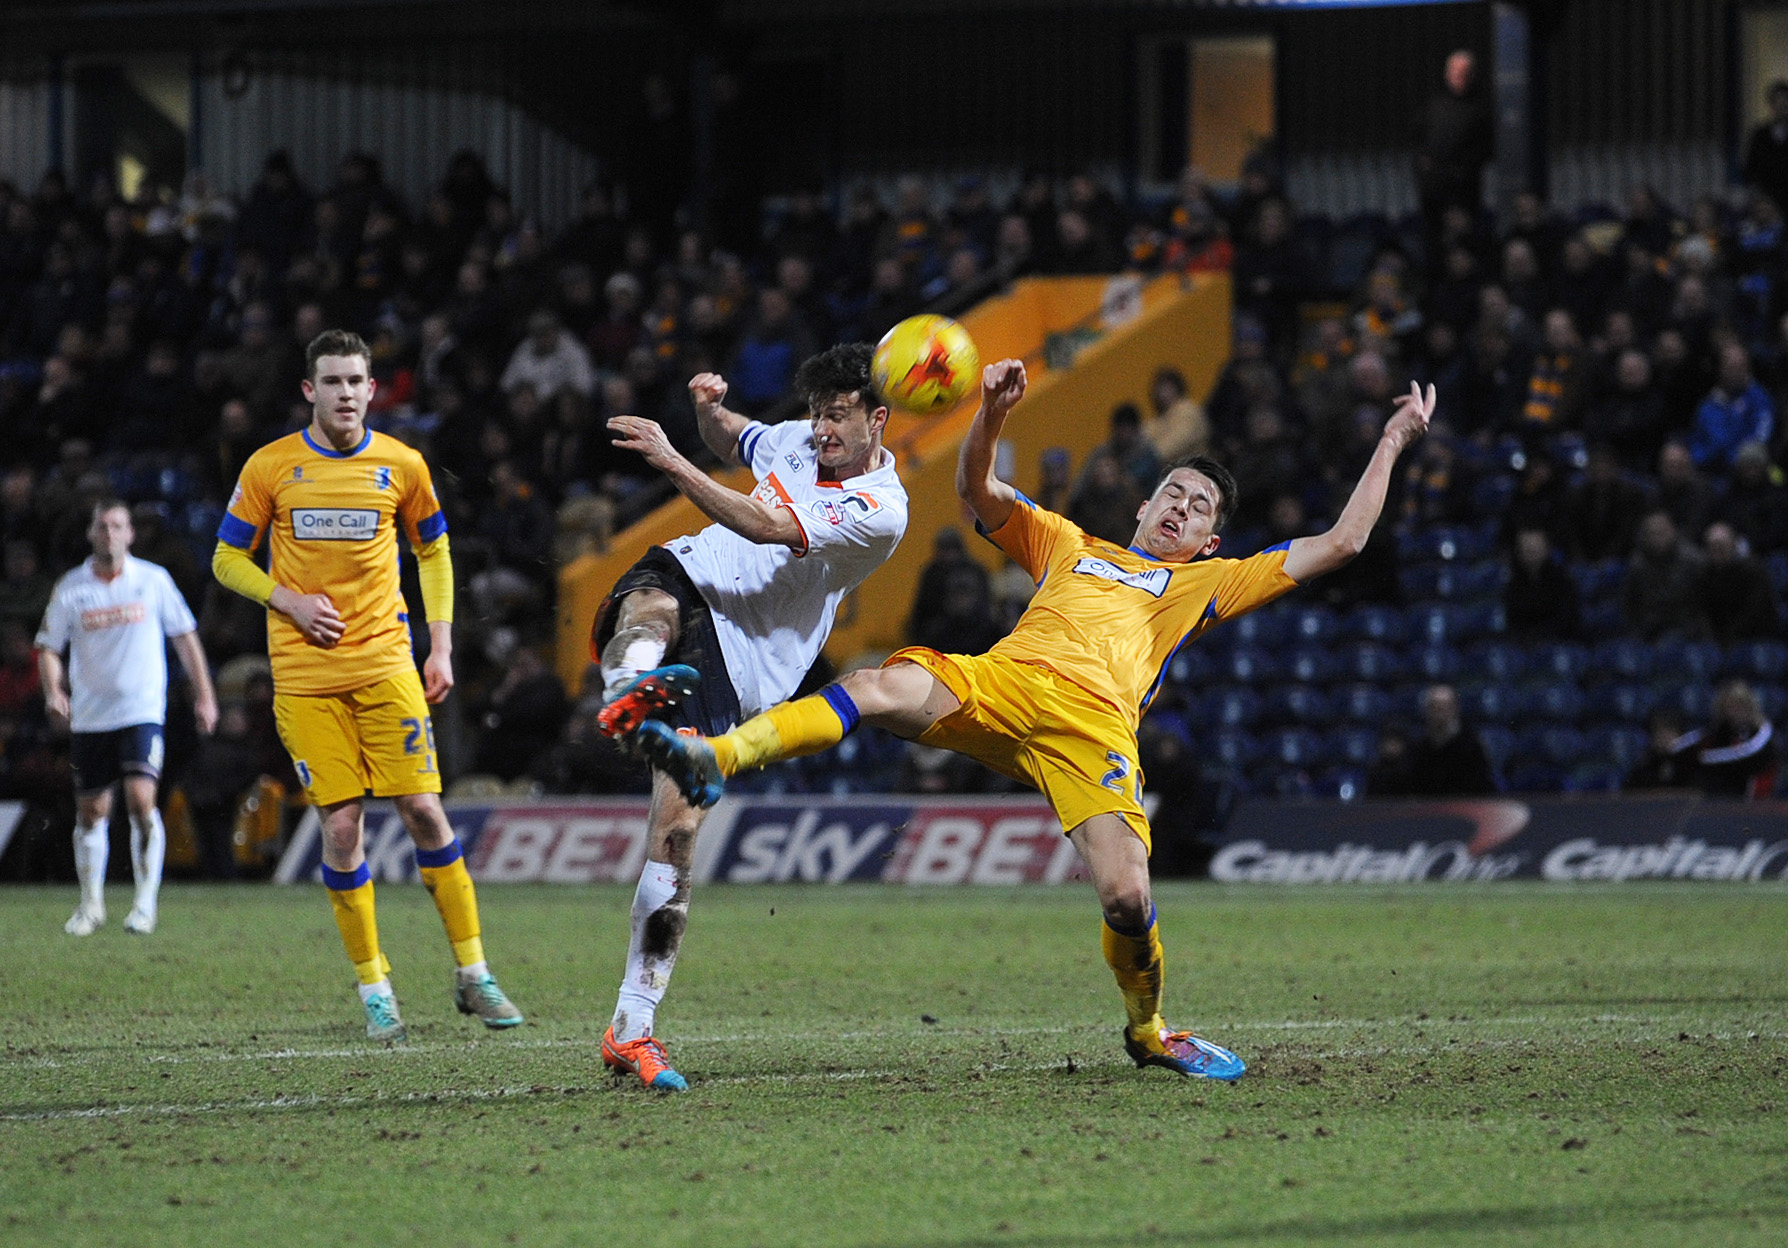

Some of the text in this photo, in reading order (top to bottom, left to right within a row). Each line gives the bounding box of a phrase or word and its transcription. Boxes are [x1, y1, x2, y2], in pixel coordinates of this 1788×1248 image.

[787, 452, 800, 471] FILA
[301, 513, 367, 528] One Call
[1090, 562, 1117, 579] On
[484, 818, 649, 882] BET
[727, 811, 1077, 884] sky BET
